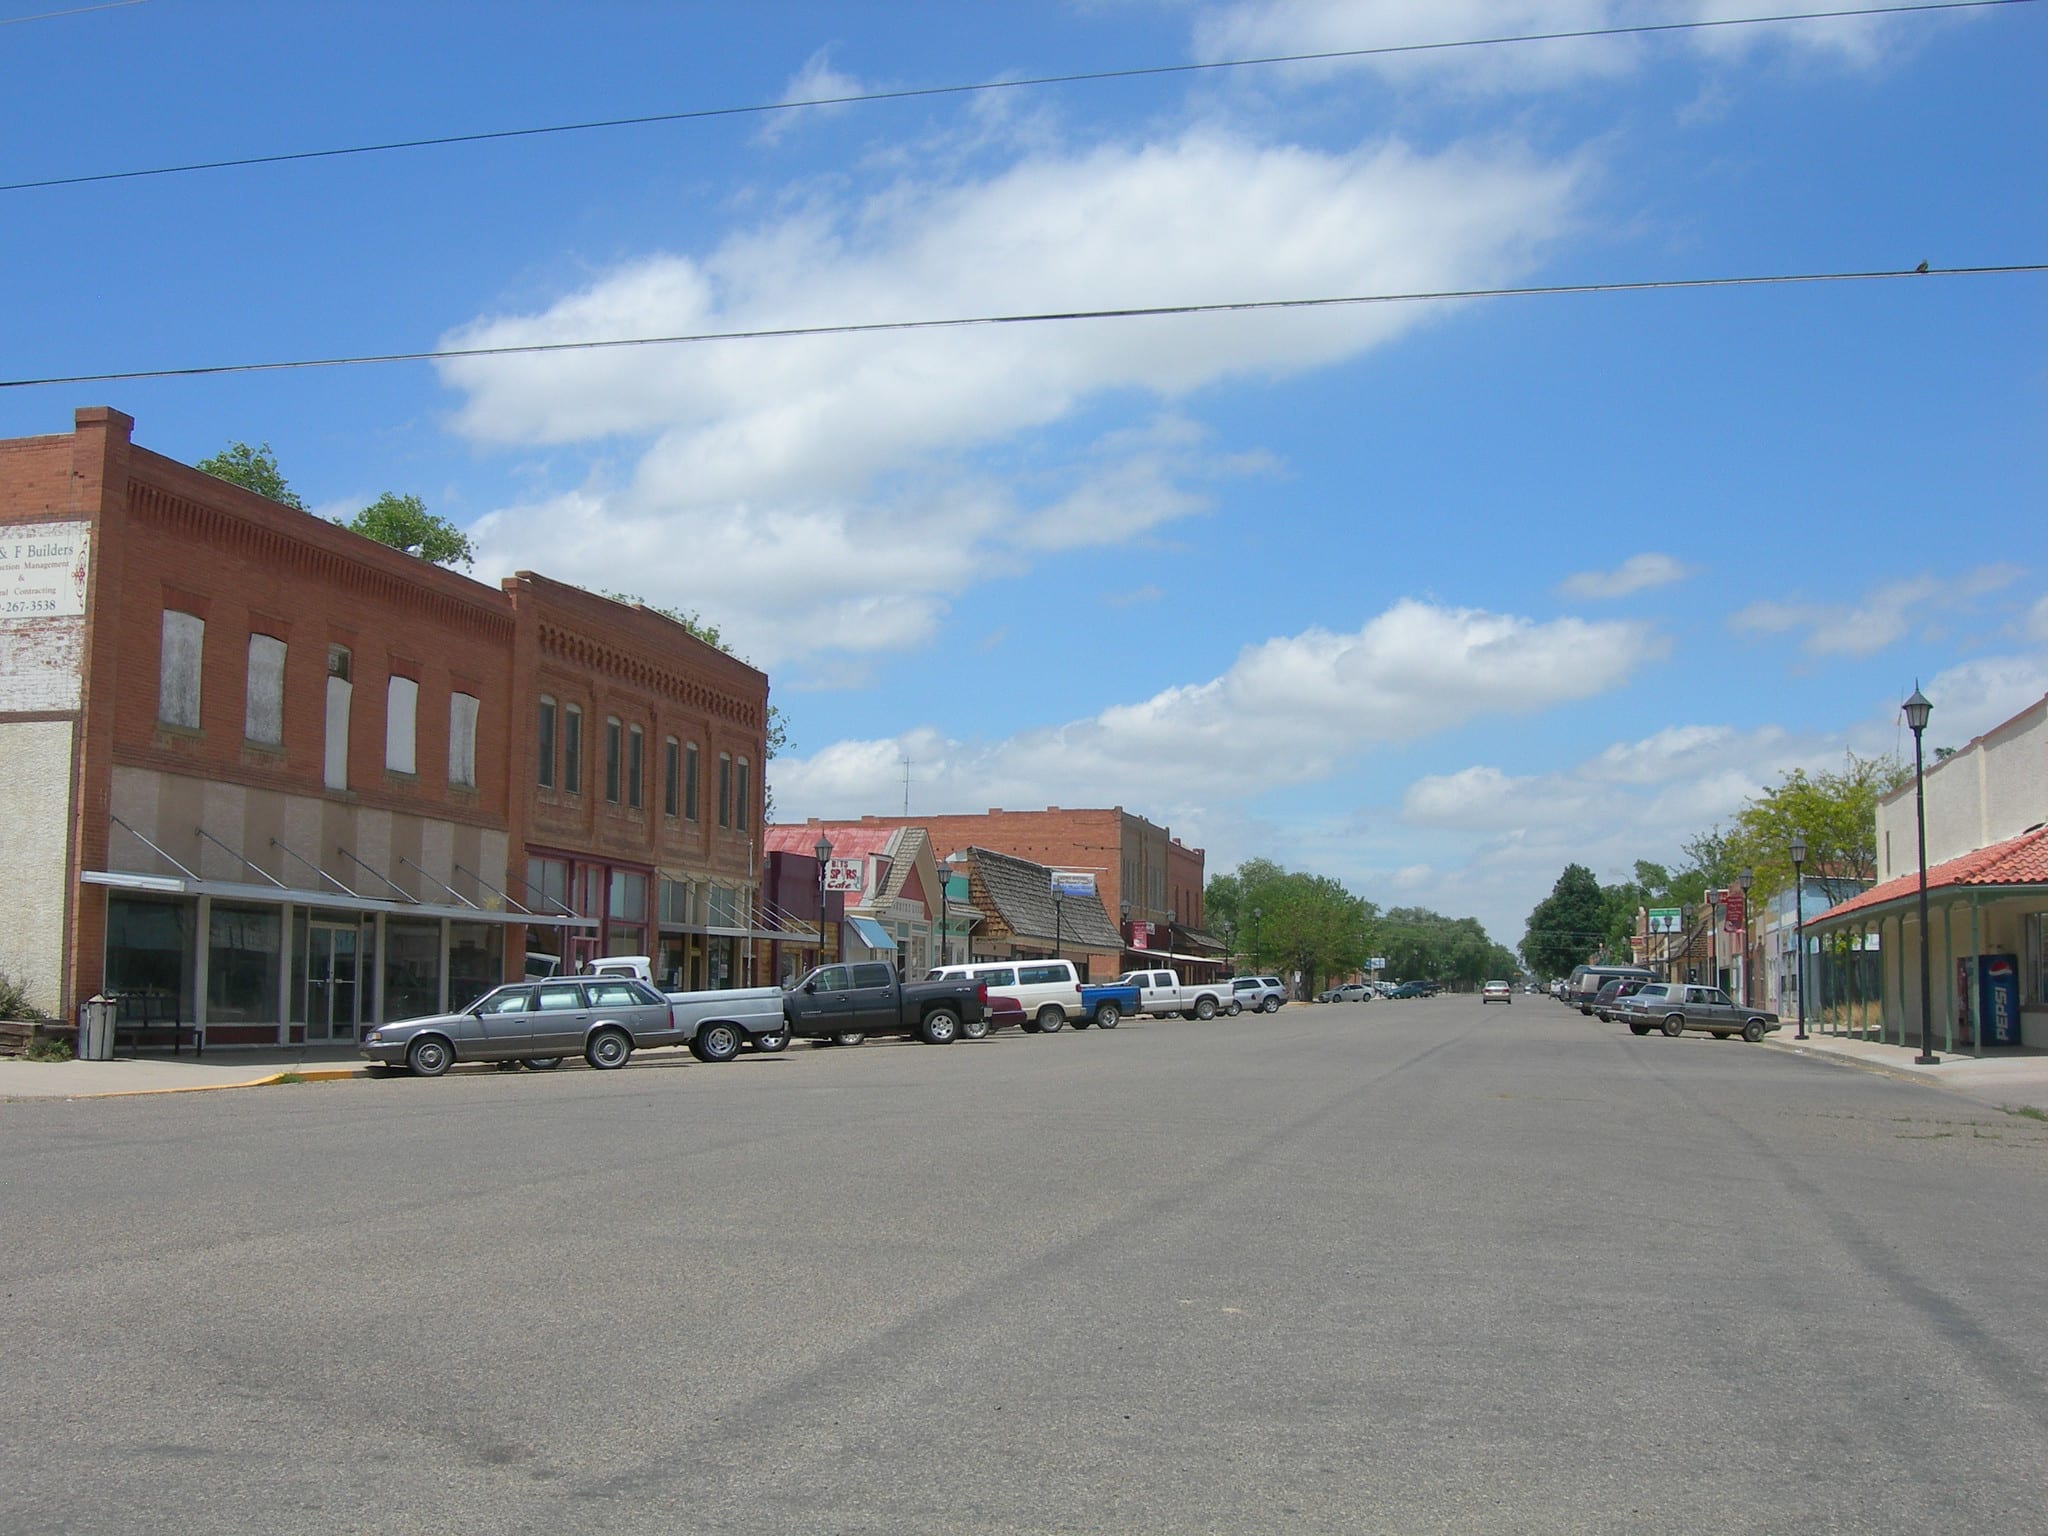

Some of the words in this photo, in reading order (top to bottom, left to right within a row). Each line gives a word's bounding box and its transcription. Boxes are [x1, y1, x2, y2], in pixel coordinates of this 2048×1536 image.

[15, 545, 22, 559] F
[28, 544, 74, 557] Builders
[24, 560, 70, 570] Management
[14, 587, 56, 595] Contracting
[0, 600, 56, 612] -267-3538
[827, 880, 852, 889] Cafe
[1994, 986, 2009, 1041] PEPSI
